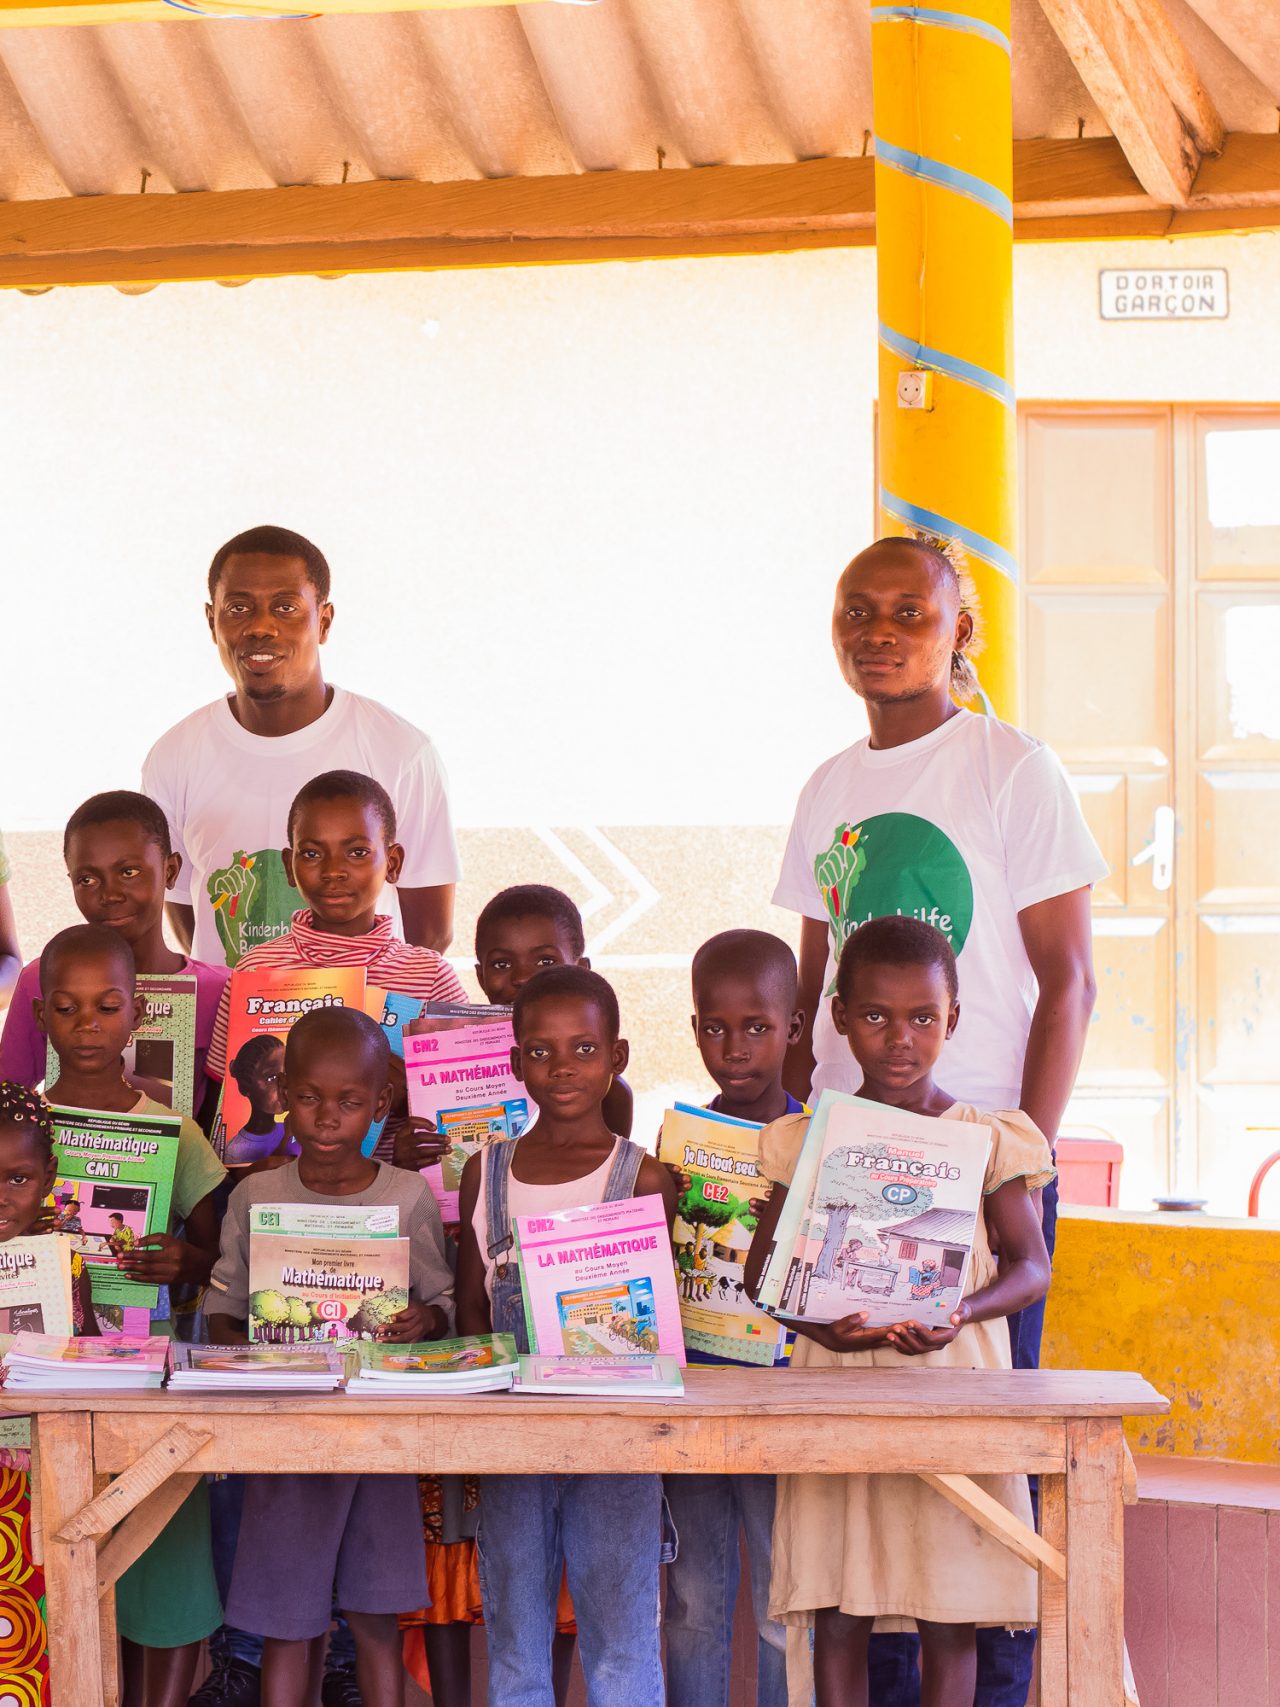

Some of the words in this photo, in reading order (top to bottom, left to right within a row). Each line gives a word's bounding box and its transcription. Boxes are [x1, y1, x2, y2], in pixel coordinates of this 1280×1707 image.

[1116, 275, 1214, 291] DORTOIR
[1115, 294, 1215, 314] GARÇON
[412, 1038, 439, 1054] CM2
[420, 1072, 437, 1087] LA
[440, 1063, 512, 1084] MATHÉMATI
[486, 1082, 506, 1091] Moyen
[58, 1129, 158, 1156] Mathématique
[888, 1147, 924, 1158] Manuel
[710, 1153, 733, 1173] tout
[847, 1150, 960, 1180] Français
[703, 1181, 729, 1202] CE2
[887, 1187, 911, 1201] CP
[258, 1211, 280, 1226] CE1
[527, 1218, 555, 1234] CM2
[537, 1253, 555, 1268] LA
[558, 1235, 658, 1265] MATHÉMATIQUE
[323, 1260, 343, 1268] premier
[584, 1265, 604, 1273] Cours
[606, 1260, 628, 1270] Moyen
[281, 1266, 385, 1294] Mathématique
[310, 1291, 328, 1299] Cours
[322, 1303, 340, 1317] CI
